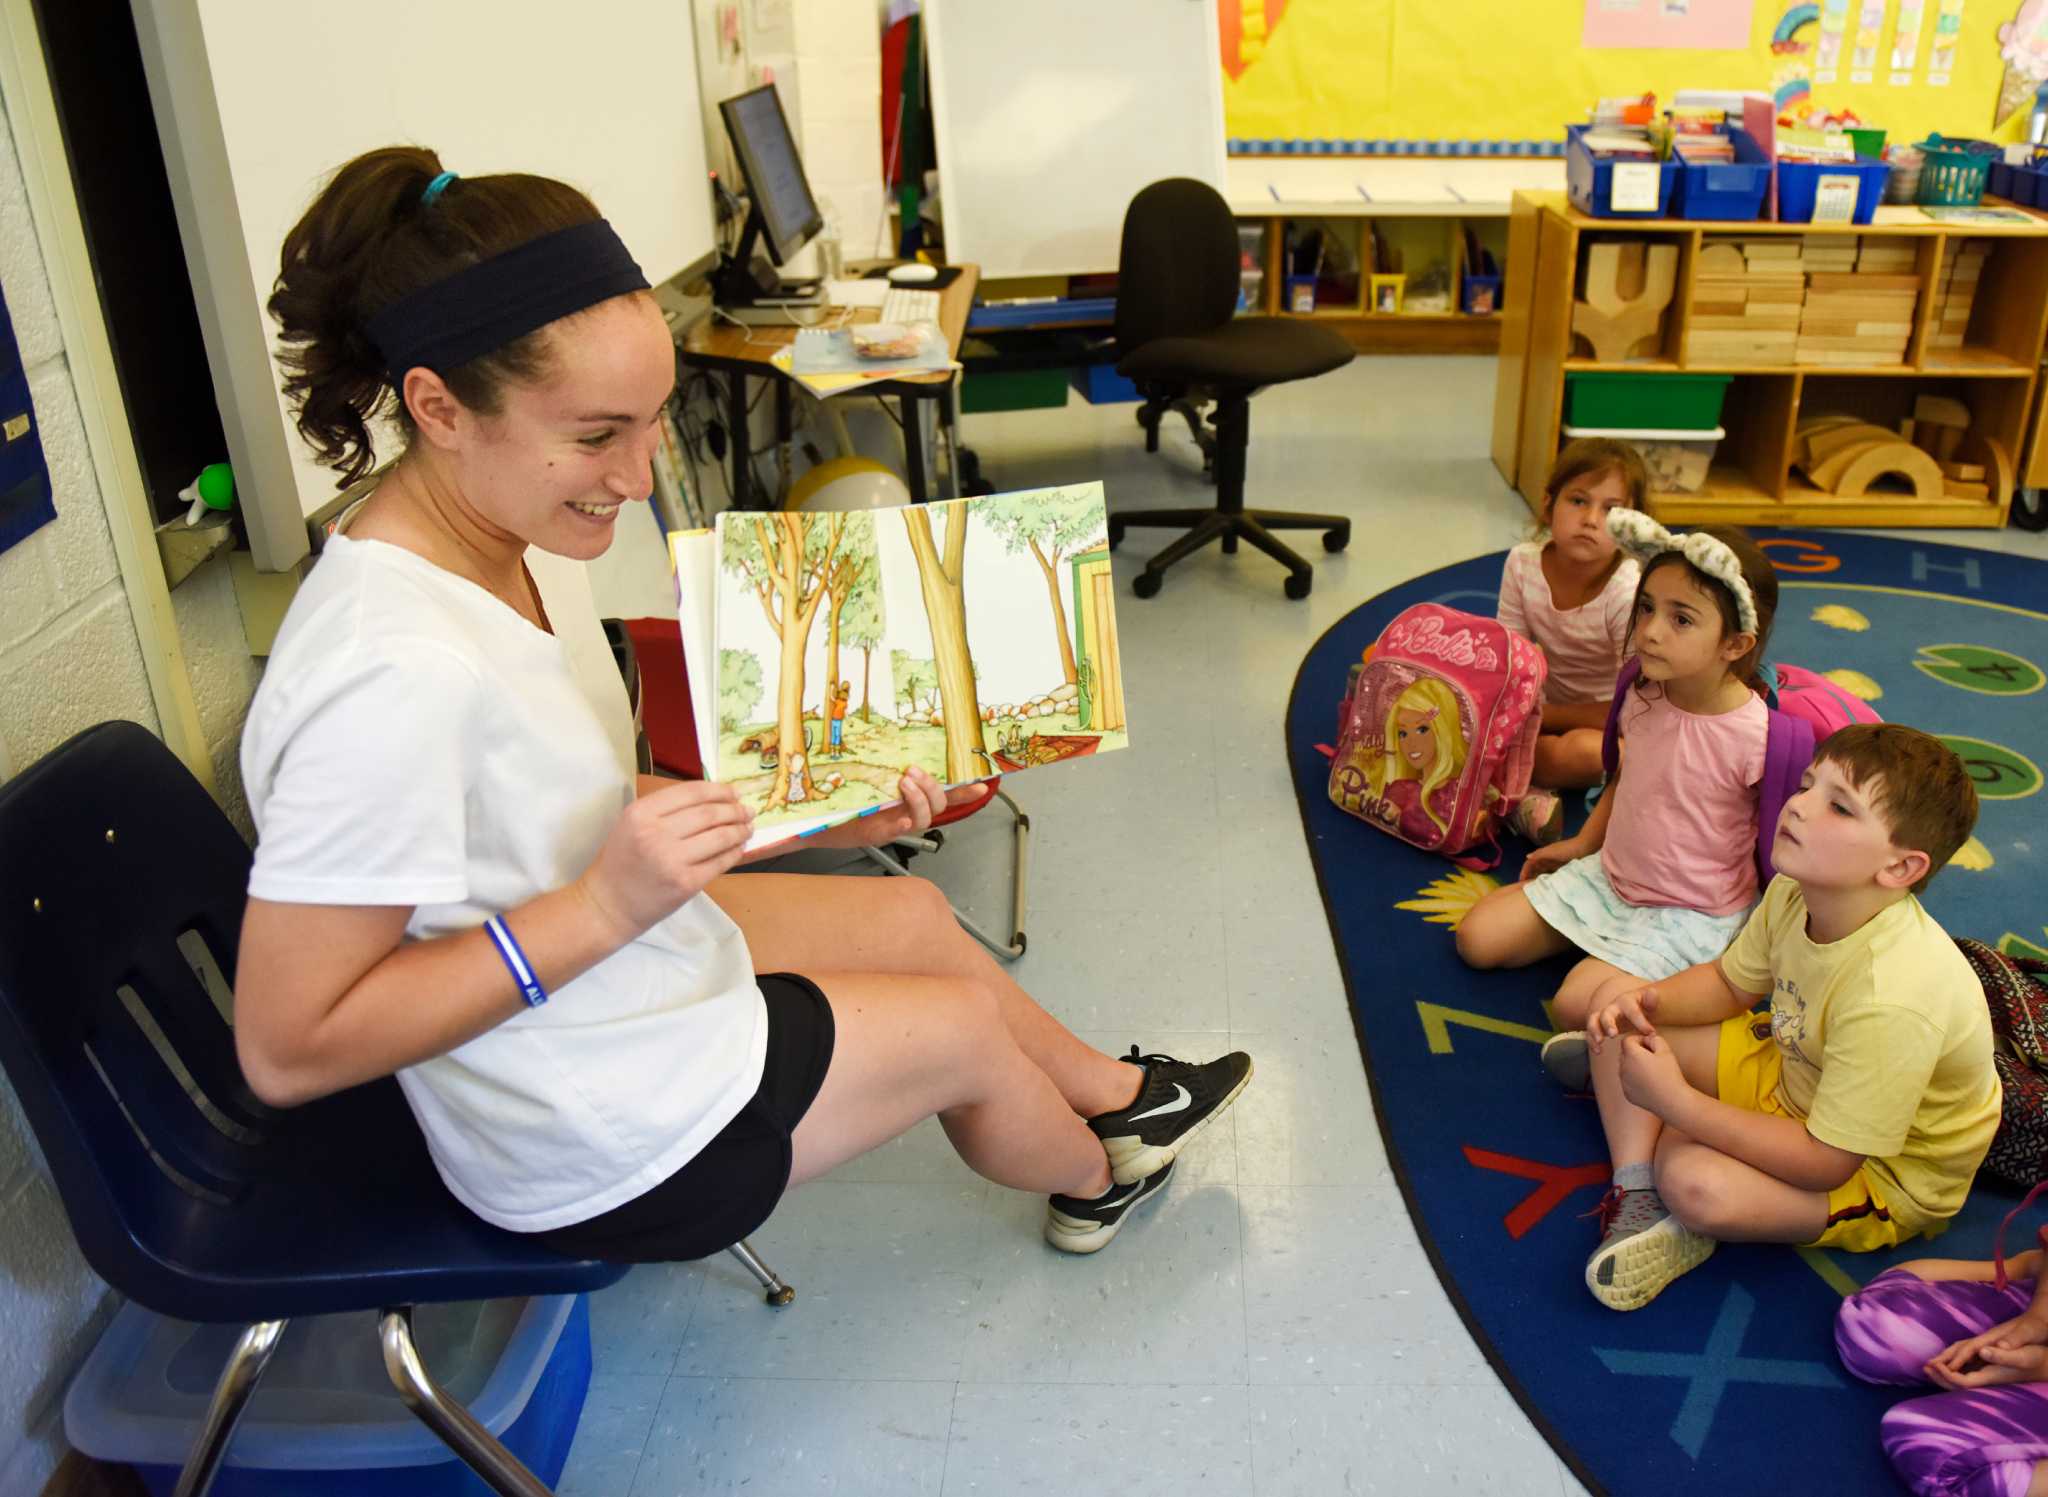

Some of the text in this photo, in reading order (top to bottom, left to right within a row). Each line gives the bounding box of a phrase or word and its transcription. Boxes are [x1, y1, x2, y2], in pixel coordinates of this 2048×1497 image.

[1757, 539, 1841, 573] G
[1912, 551, 1981, 588] H
[1400, 615, 1475, 666] Barbie
[1967, 663, 2020, 681] 4
[1461, 1146, 1613, 1240] Y
[1591, 1280, 1847, 1461] X
